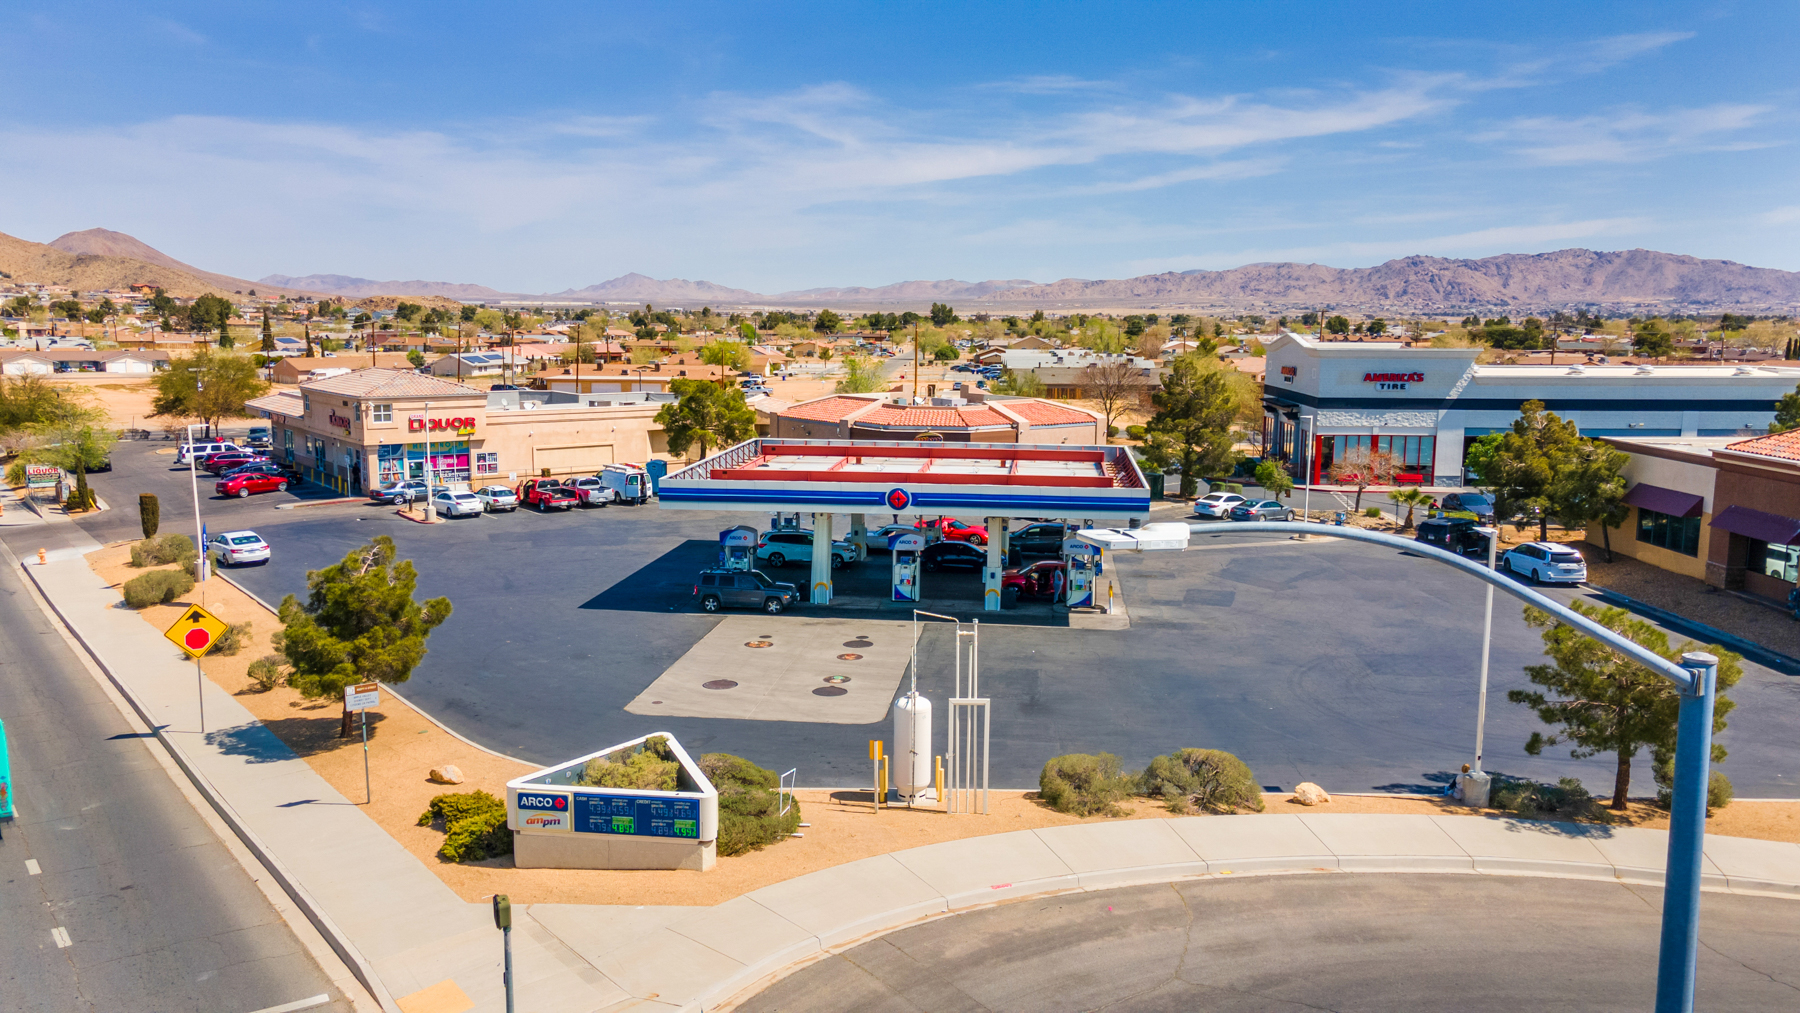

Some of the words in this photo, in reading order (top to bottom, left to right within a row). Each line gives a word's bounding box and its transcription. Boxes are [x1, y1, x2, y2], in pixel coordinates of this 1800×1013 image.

[1363, 372, 1424, 382] AMERICA'S
[410, 417, 475, 430] LIQUOR
[520, 796, 552, 807] ARCO
[526, 817, 561, 828] ampm
